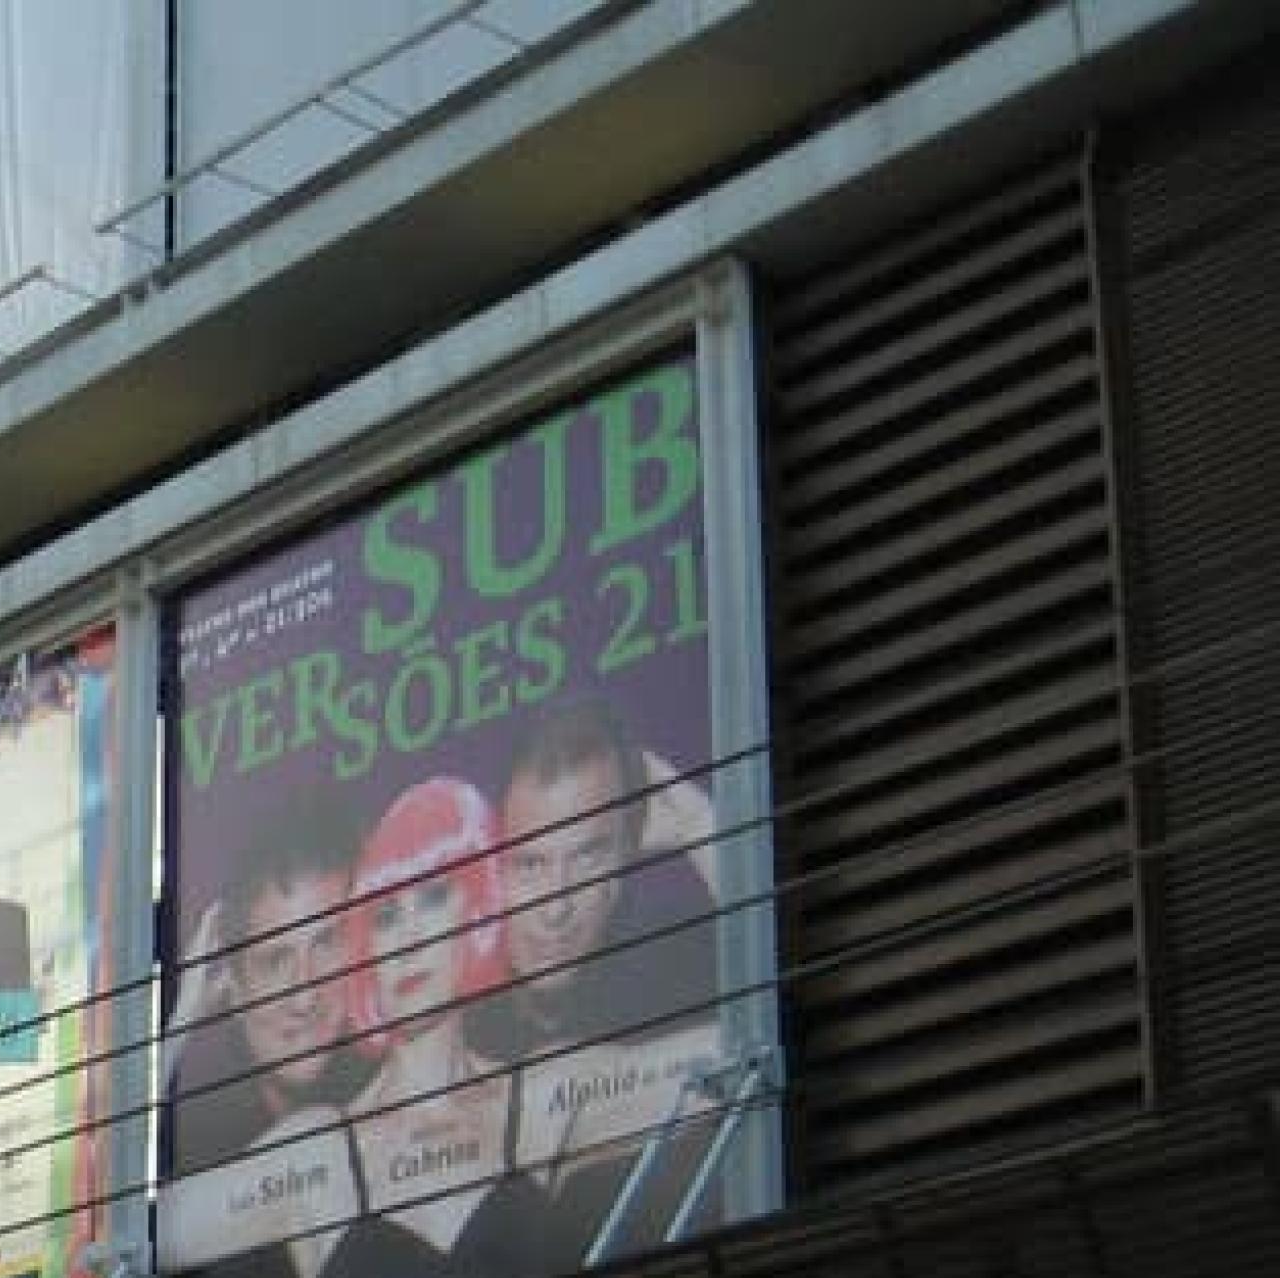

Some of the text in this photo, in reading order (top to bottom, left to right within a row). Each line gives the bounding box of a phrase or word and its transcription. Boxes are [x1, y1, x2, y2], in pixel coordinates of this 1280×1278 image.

[360, 361, 704, 655] SUB
[180, 542, 708, 788] VERSÕES 21
